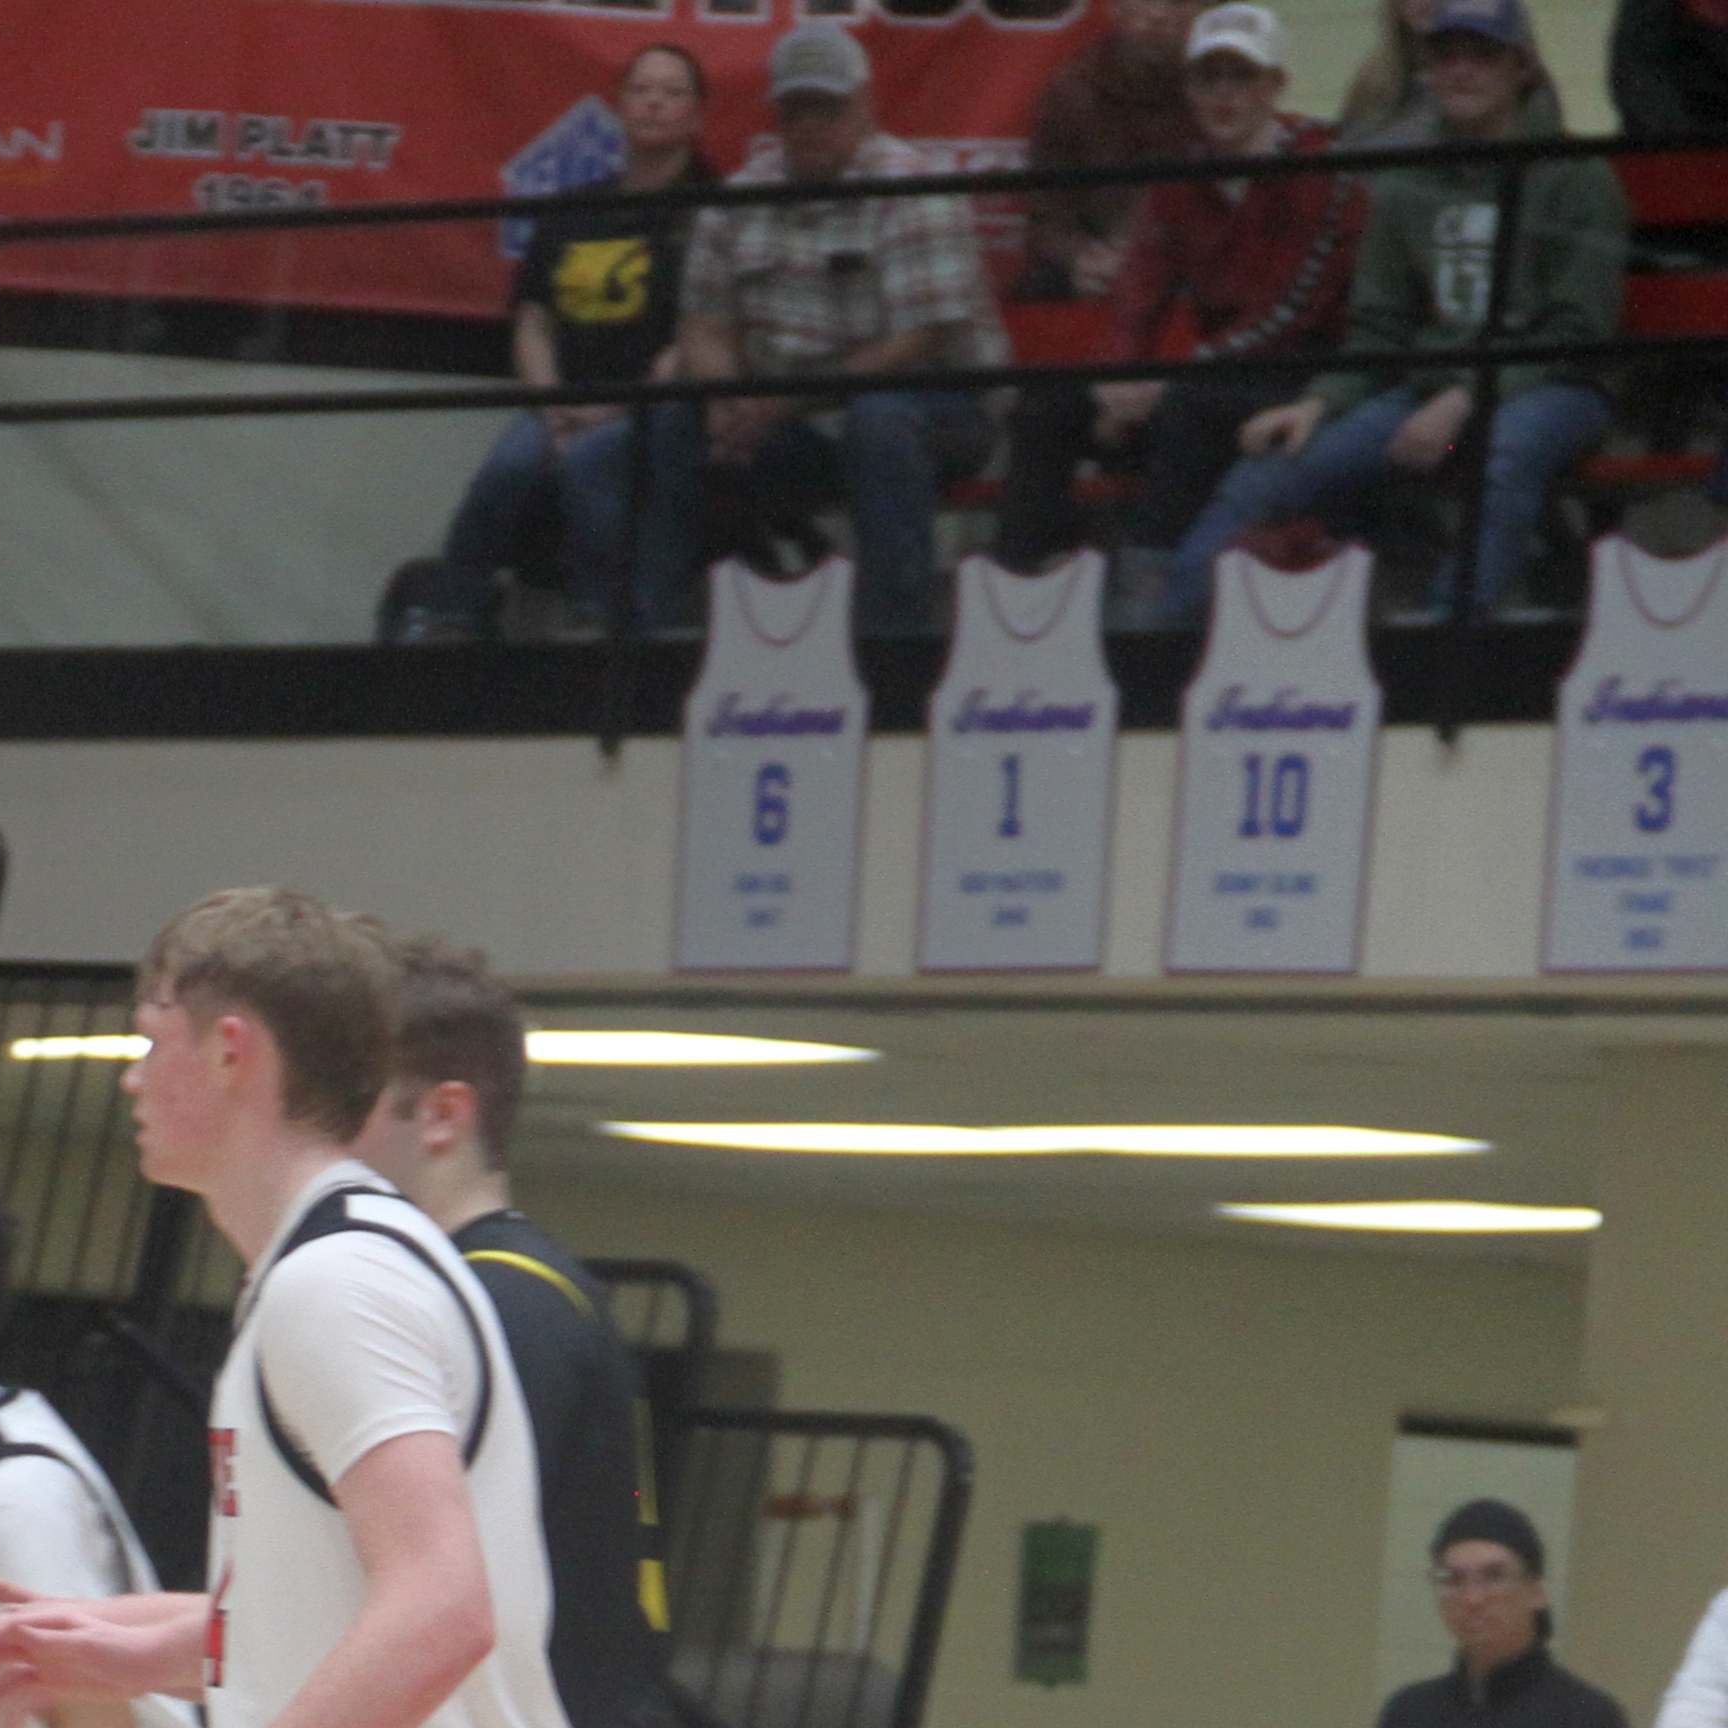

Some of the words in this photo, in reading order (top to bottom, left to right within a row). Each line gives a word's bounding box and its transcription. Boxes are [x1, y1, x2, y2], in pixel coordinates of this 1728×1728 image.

[127, 108, 226, 158] JIM
[235, 113, 401, 170] PLATT
[754, 763, 790, 846] 6
[998, 753, 1022, 838] 1
[1237, 753, 1310, 839] 10
[1635, 746, 1676, 832] 3
